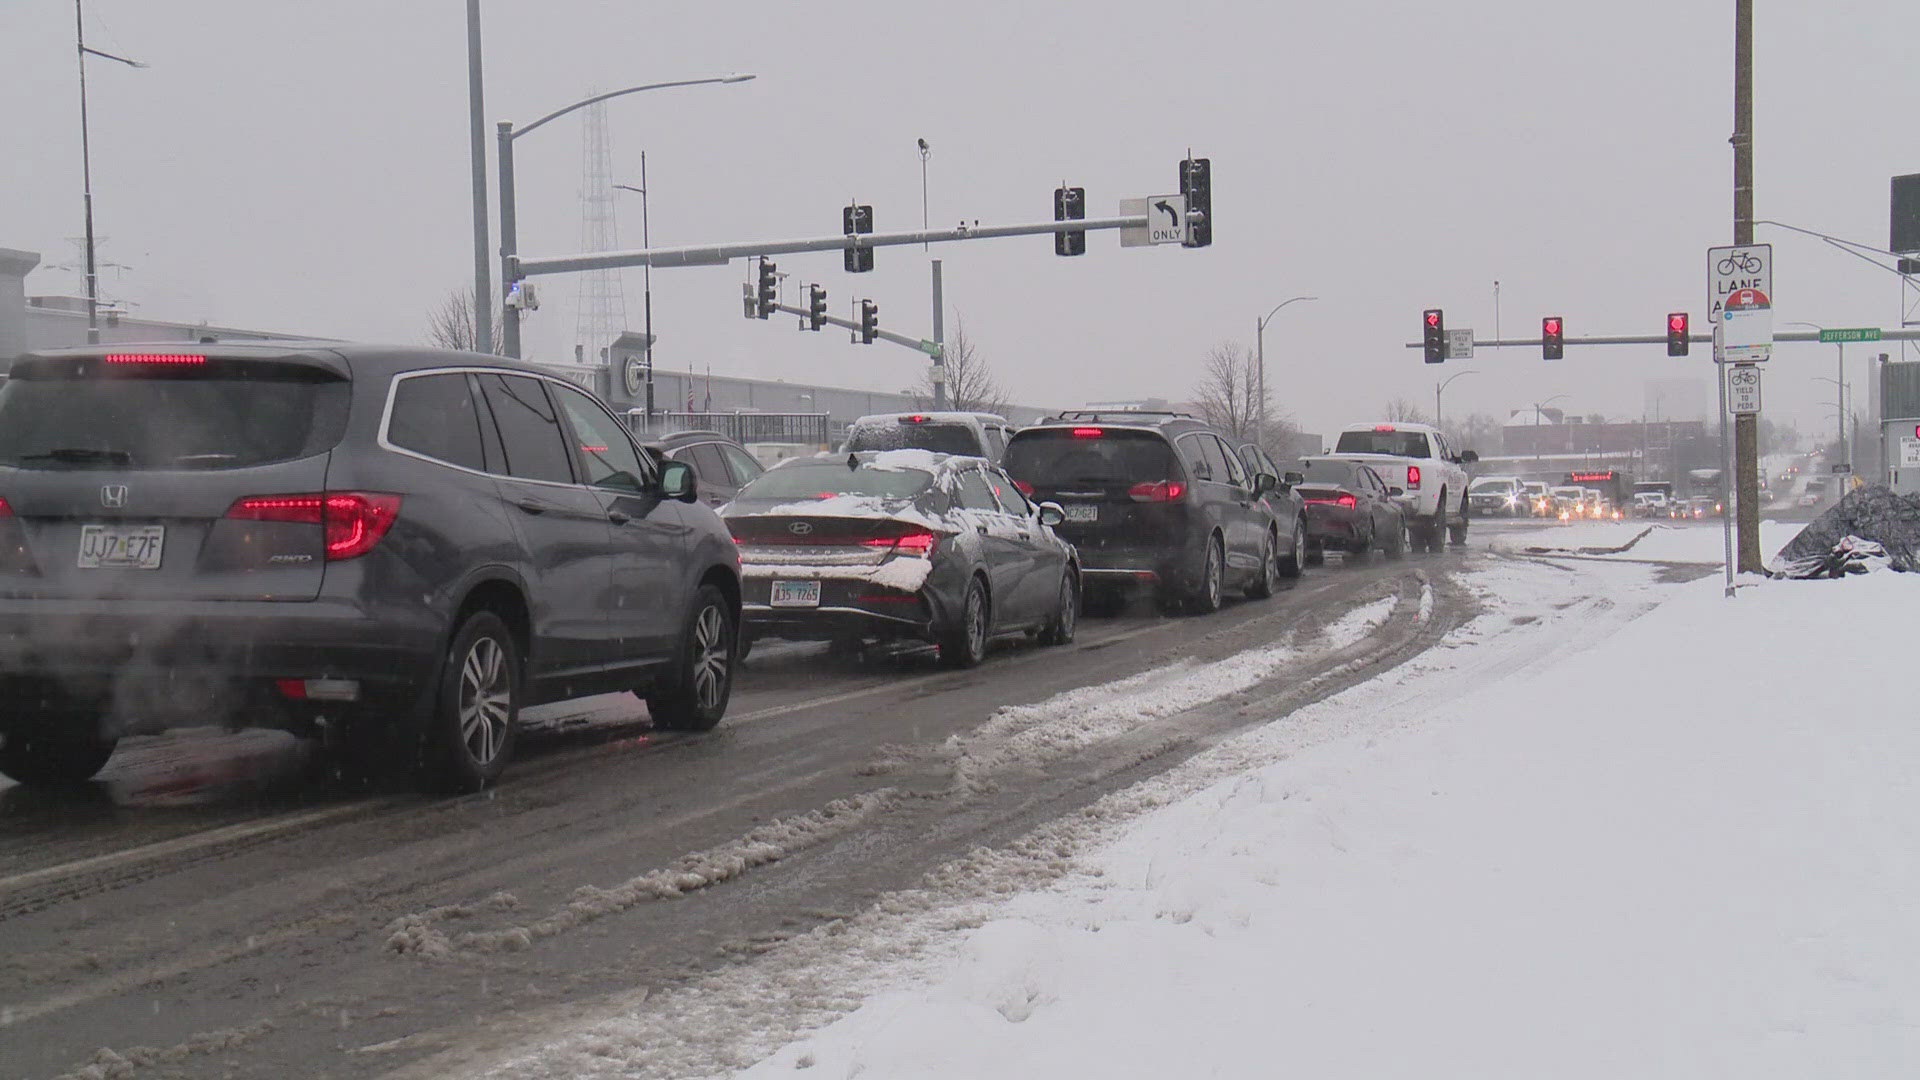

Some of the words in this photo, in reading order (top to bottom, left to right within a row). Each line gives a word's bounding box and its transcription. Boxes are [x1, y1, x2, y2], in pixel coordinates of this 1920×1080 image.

[1153, 230, 1181, 240] ONLY
[1822, 331, 1861, 341] JEFFERSON
[1864, 330, 1879, 340] AVE
[84, 536, 118, 558] JJ7
[126, 535, 160, 558] E7F
[797, 589, 818, 601] 7265
